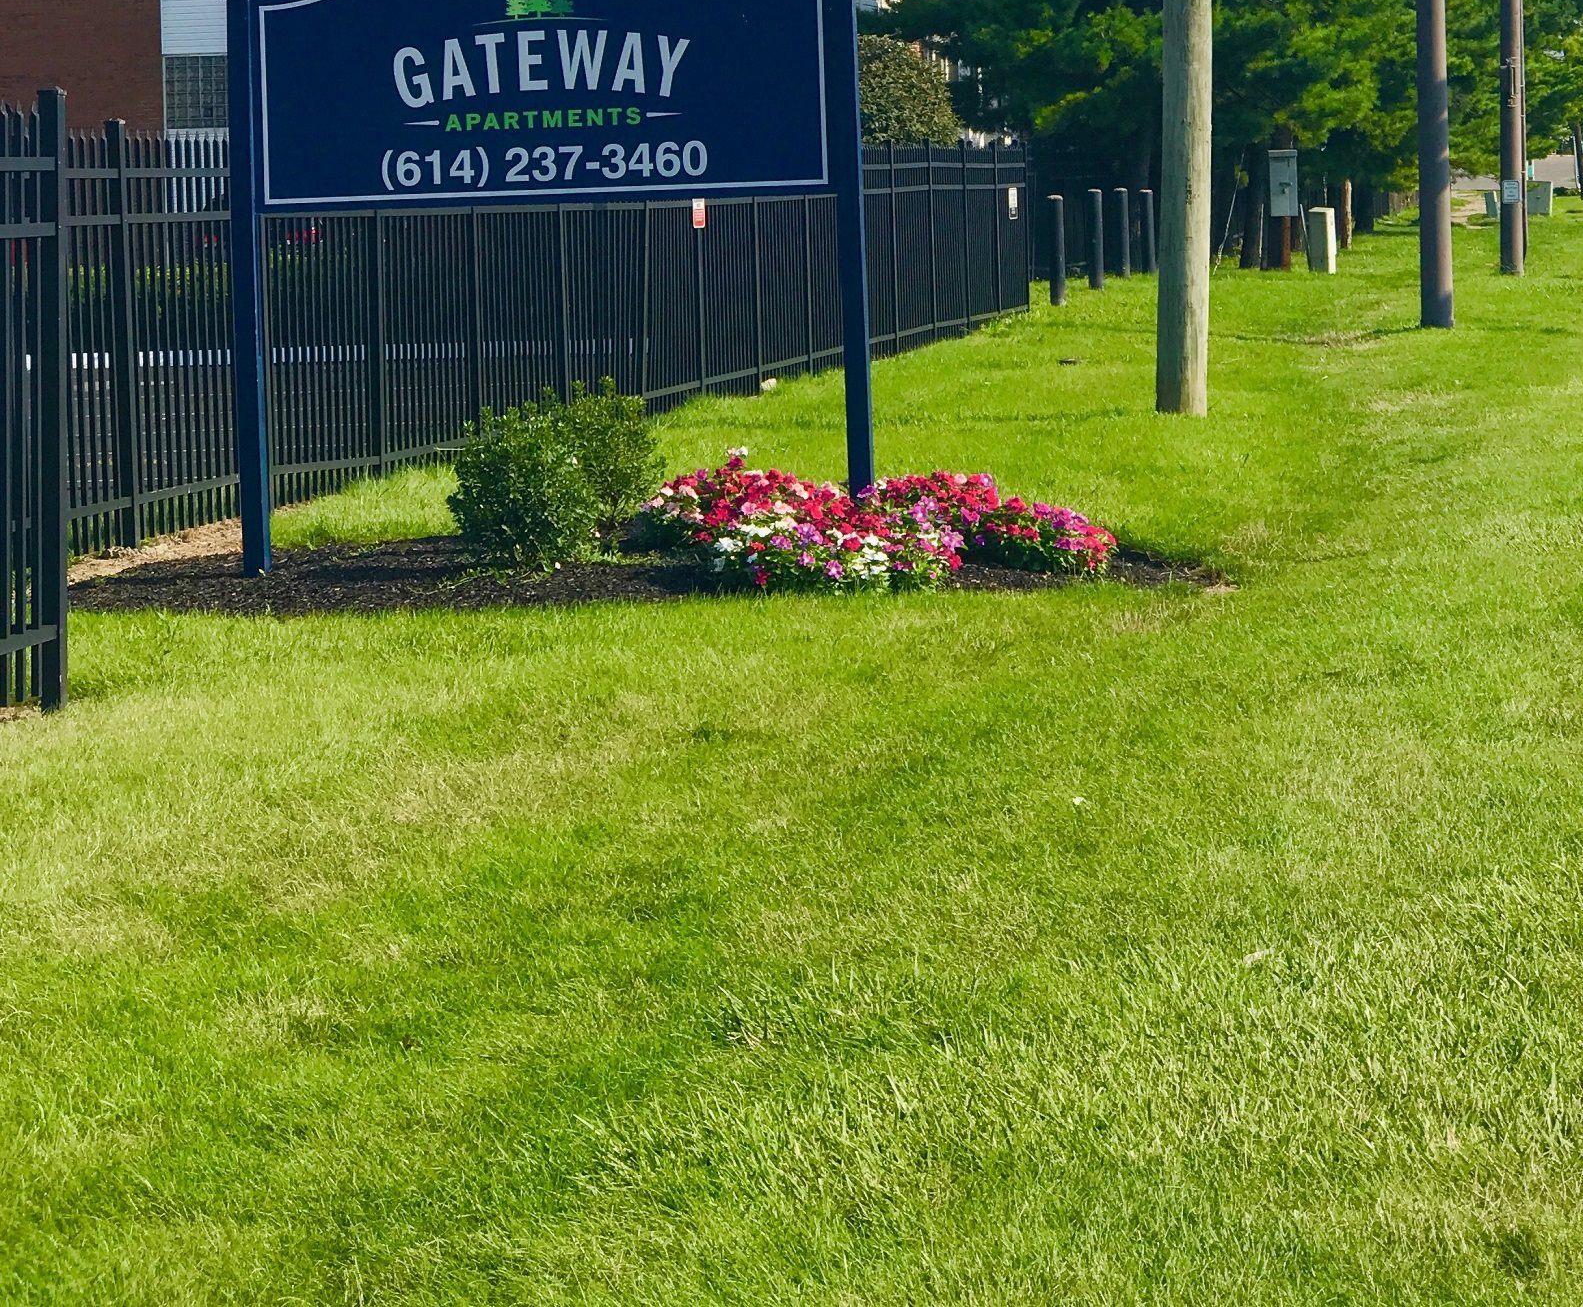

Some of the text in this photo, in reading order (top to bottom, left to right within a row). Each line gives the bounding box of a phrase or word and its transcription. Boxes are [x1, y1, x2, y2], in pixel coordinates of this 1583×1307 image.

[393, 29, 691, 109] GATEWAY
[444, 107, 642, 132] APARTMENTS
[381, 140, 708, 191] (614) 237-3460
